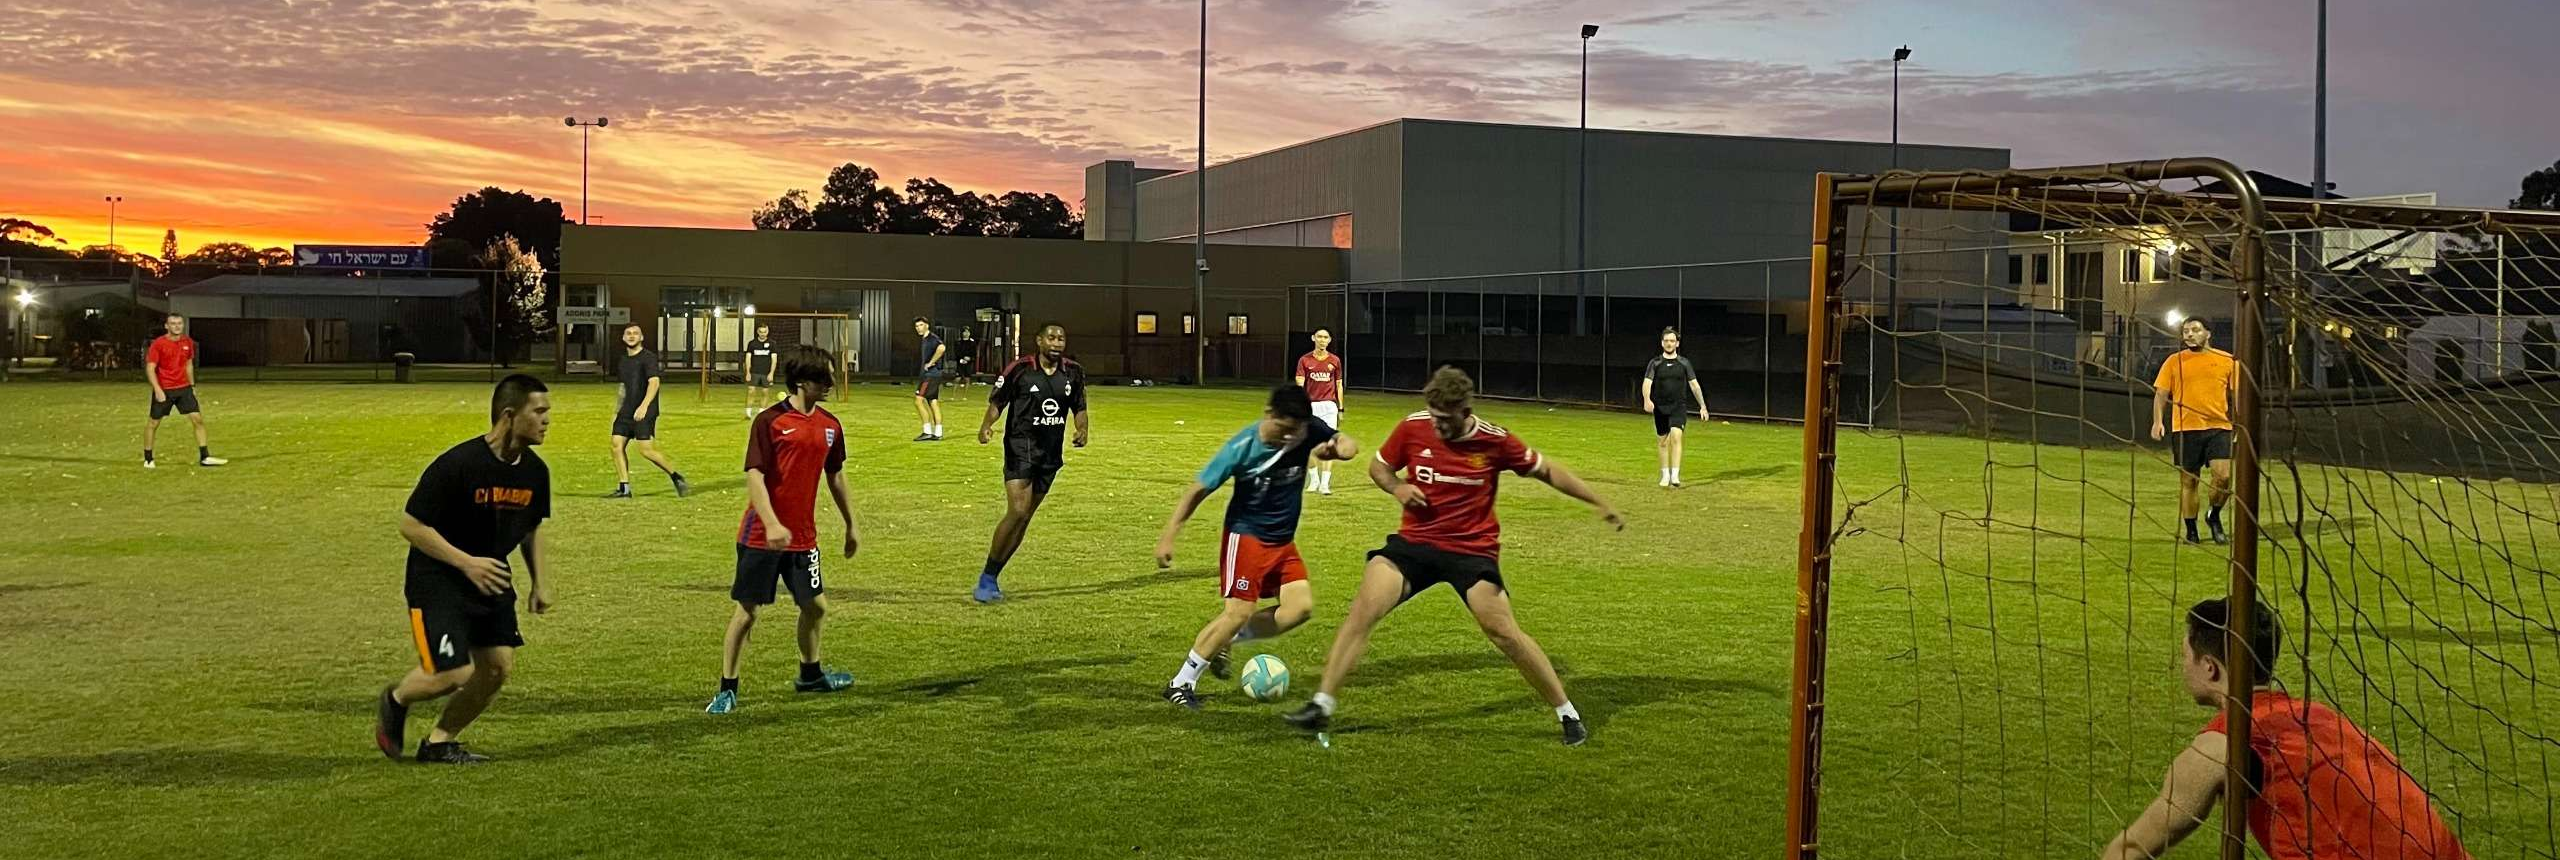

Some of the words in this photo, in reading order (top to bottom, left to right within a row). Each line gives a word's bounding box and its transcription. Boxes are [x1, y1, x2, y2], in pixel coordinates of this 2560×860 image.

[328, 252, 342, 264] חי
[346, 249, 387, 264] ישראל
[390, 253, 408, 265] עם
[1032, 416, 1065, 426] ZAFIRA
[439, 633, 455, 658] 4
